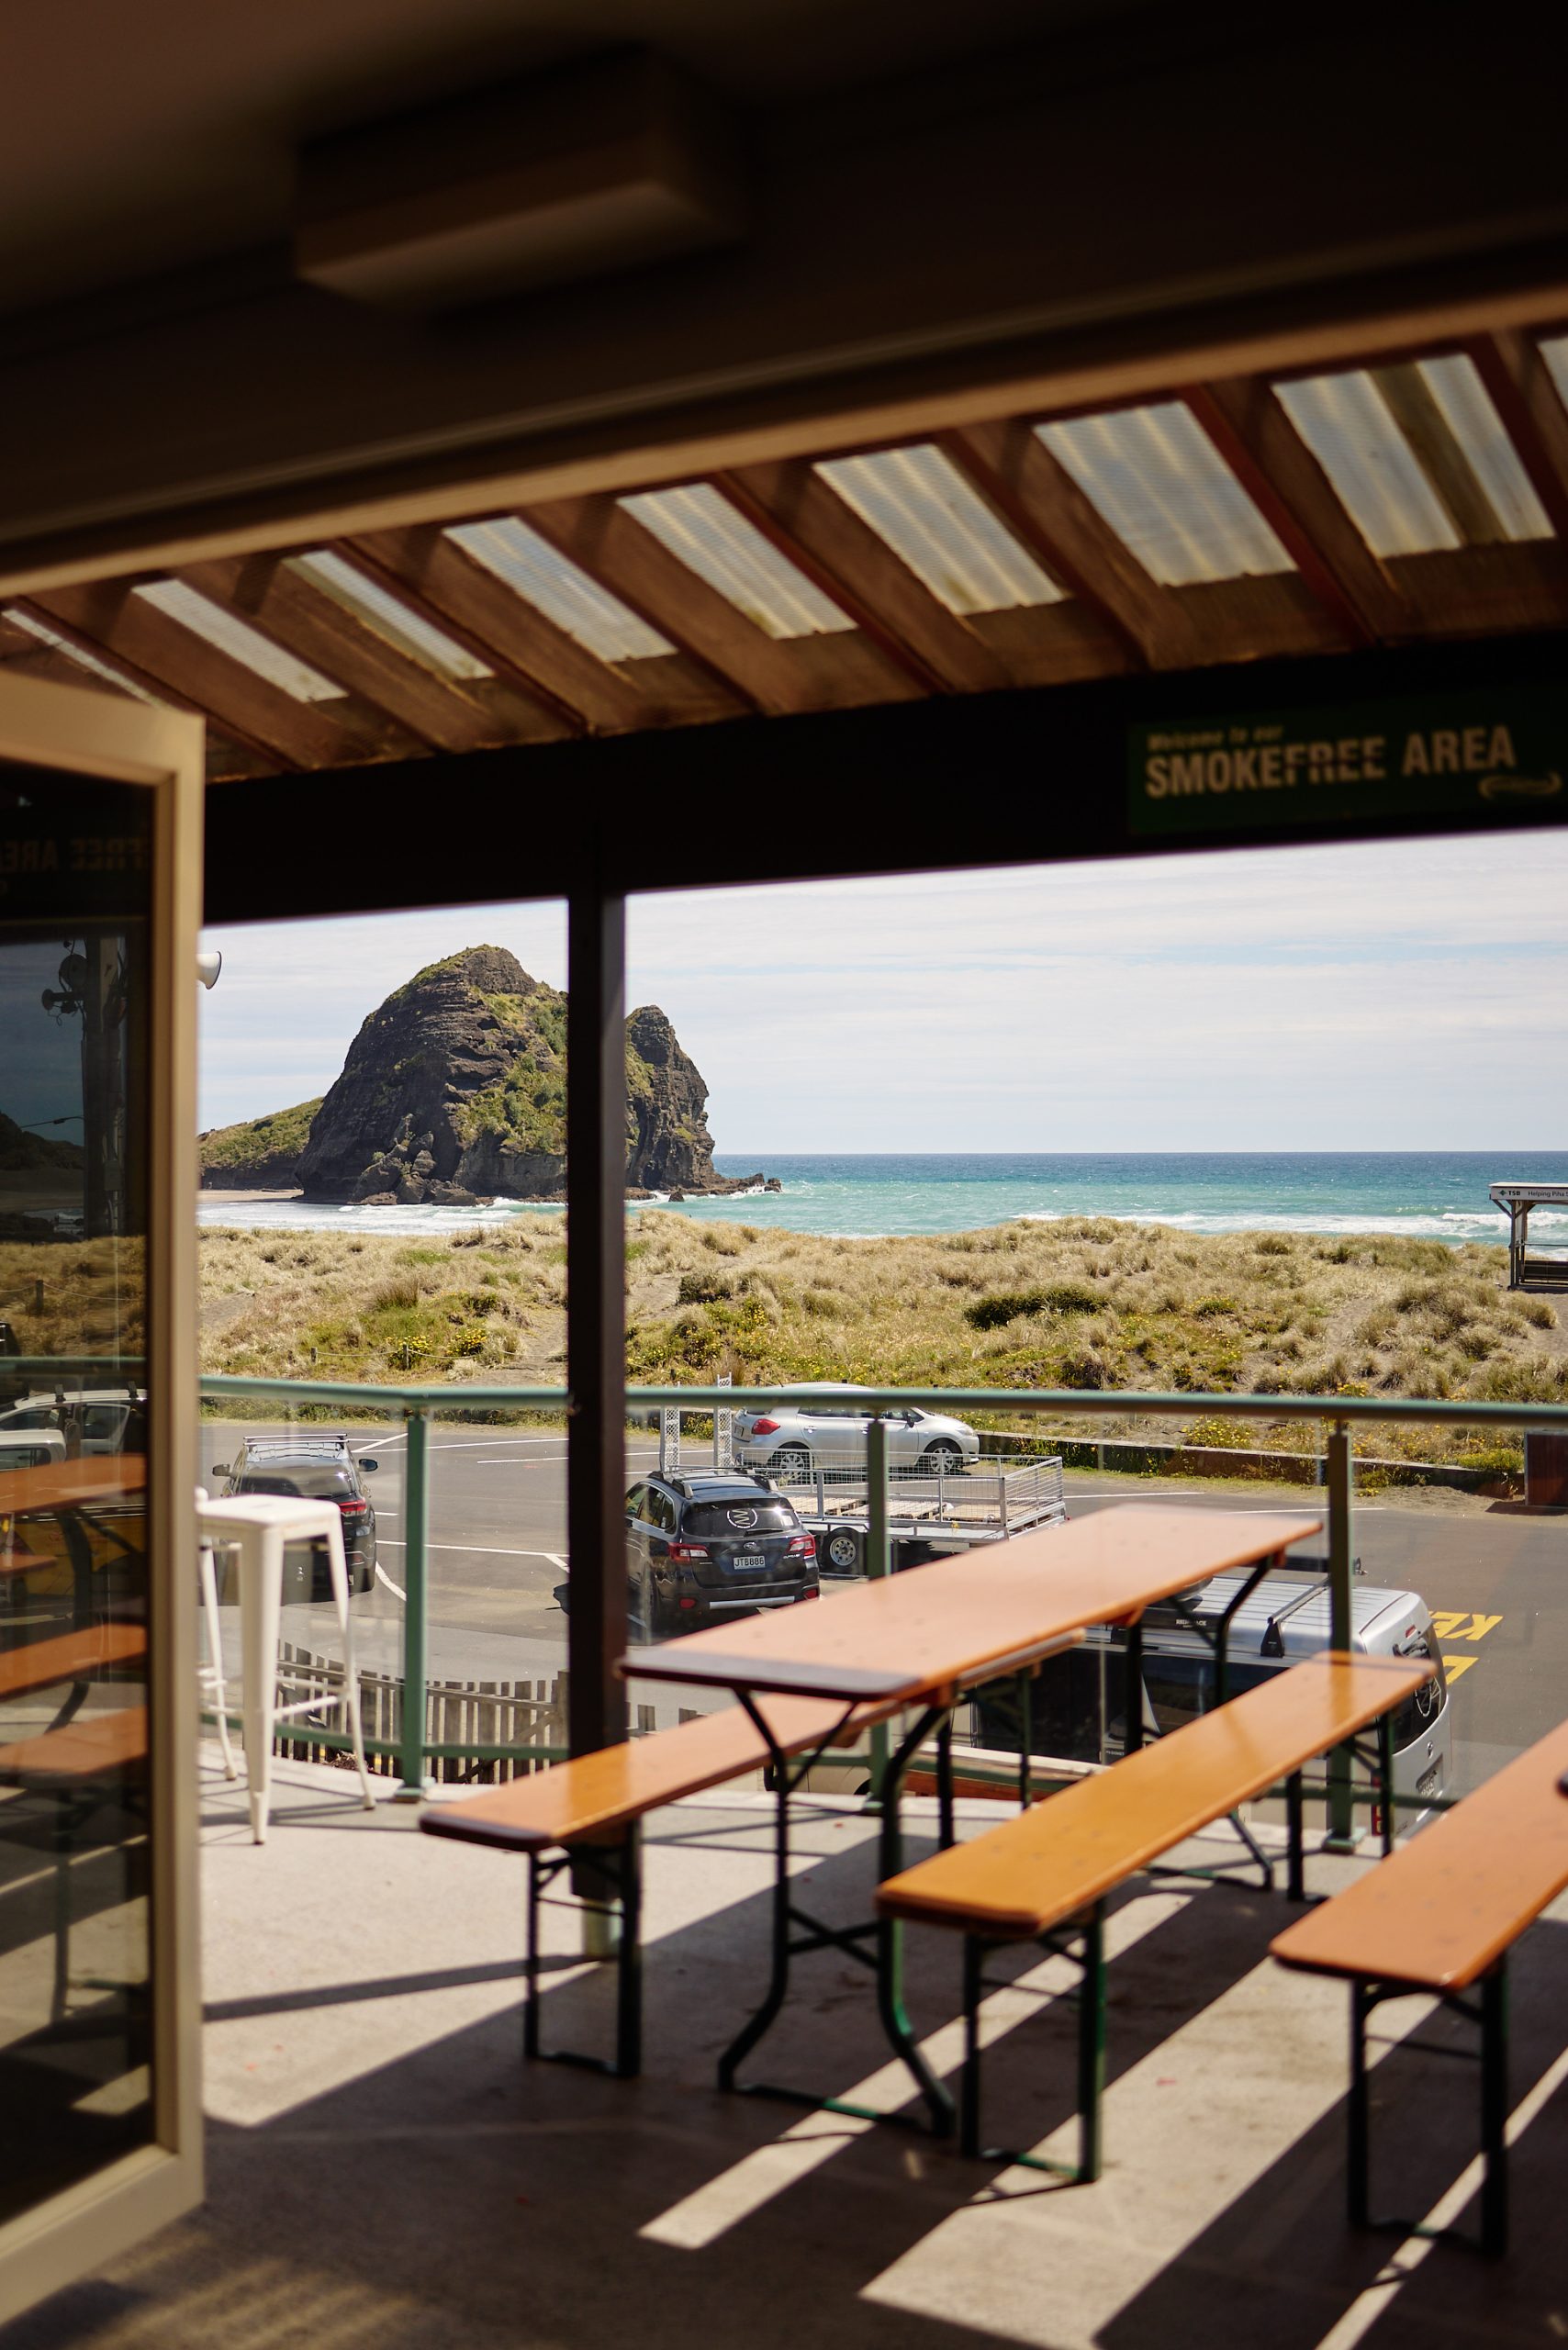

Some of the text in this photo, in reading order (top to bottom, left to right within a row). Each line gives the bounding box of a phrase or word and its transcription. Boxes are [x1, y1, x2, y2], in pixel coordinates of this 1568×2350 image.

[1228, 727, 1248, 745] to
[1252, 725, 1284, 743] our
[1144, 723, 1518, 800] SMOKEFREE AREA
